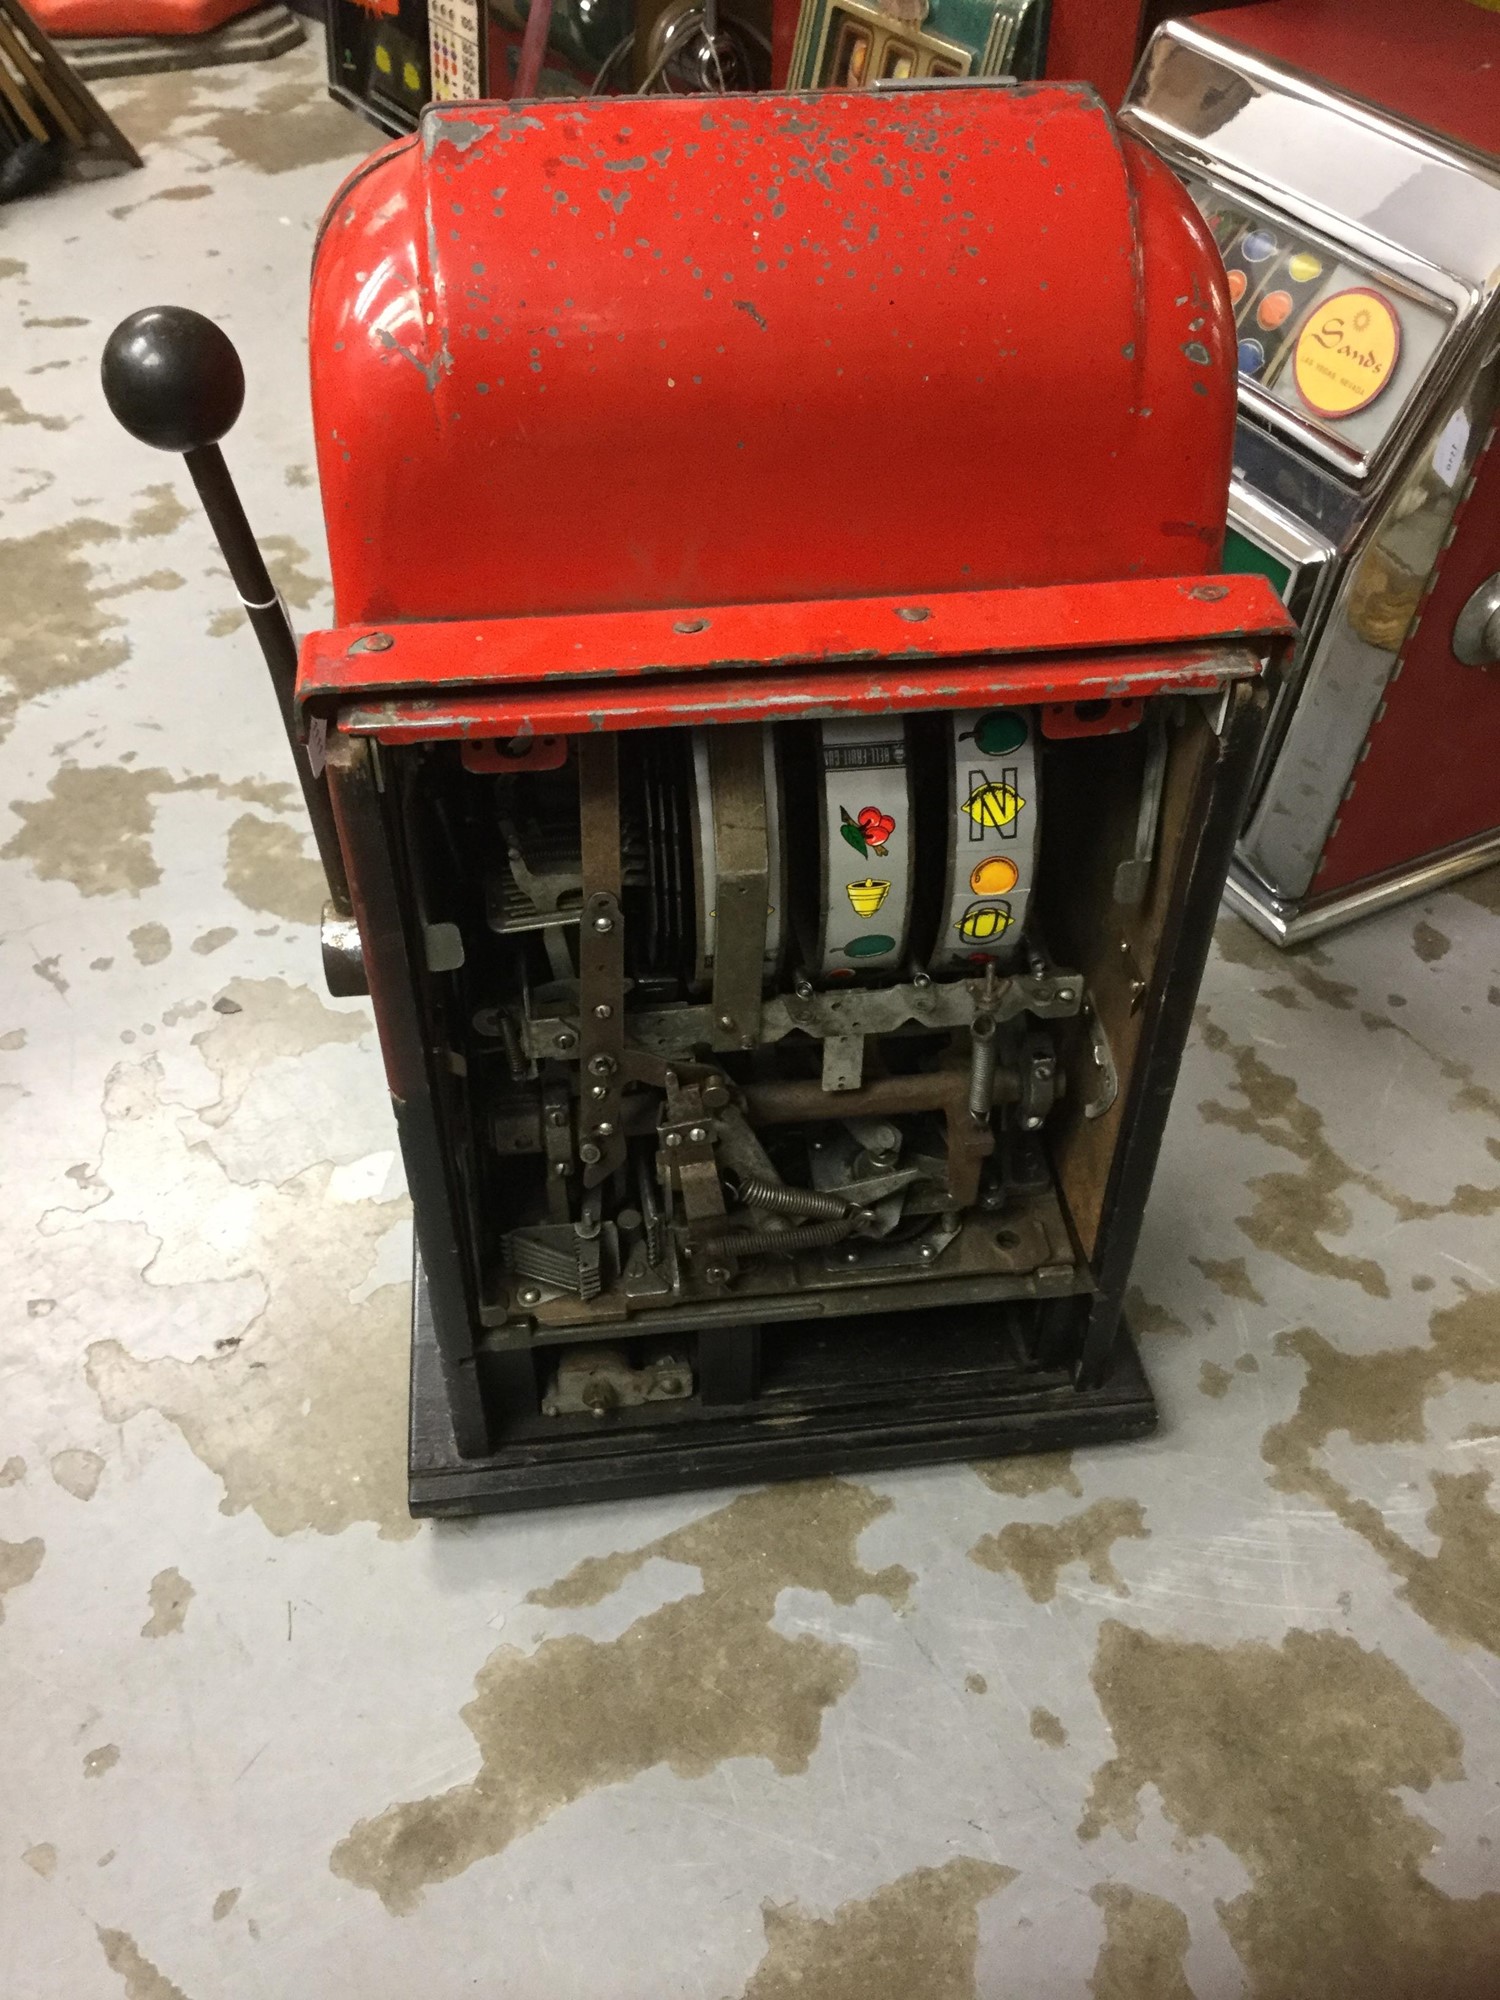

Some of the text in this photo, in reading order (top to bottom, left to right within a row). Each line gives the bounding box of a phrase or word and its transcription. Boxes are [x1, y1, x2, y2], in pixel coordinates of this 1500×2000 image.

[1307, 318, 1382, 373] Sands
[1301, 356, 1365, 396] LAS VEGAS NEVADA
[968, 767, 1018, 842] N
